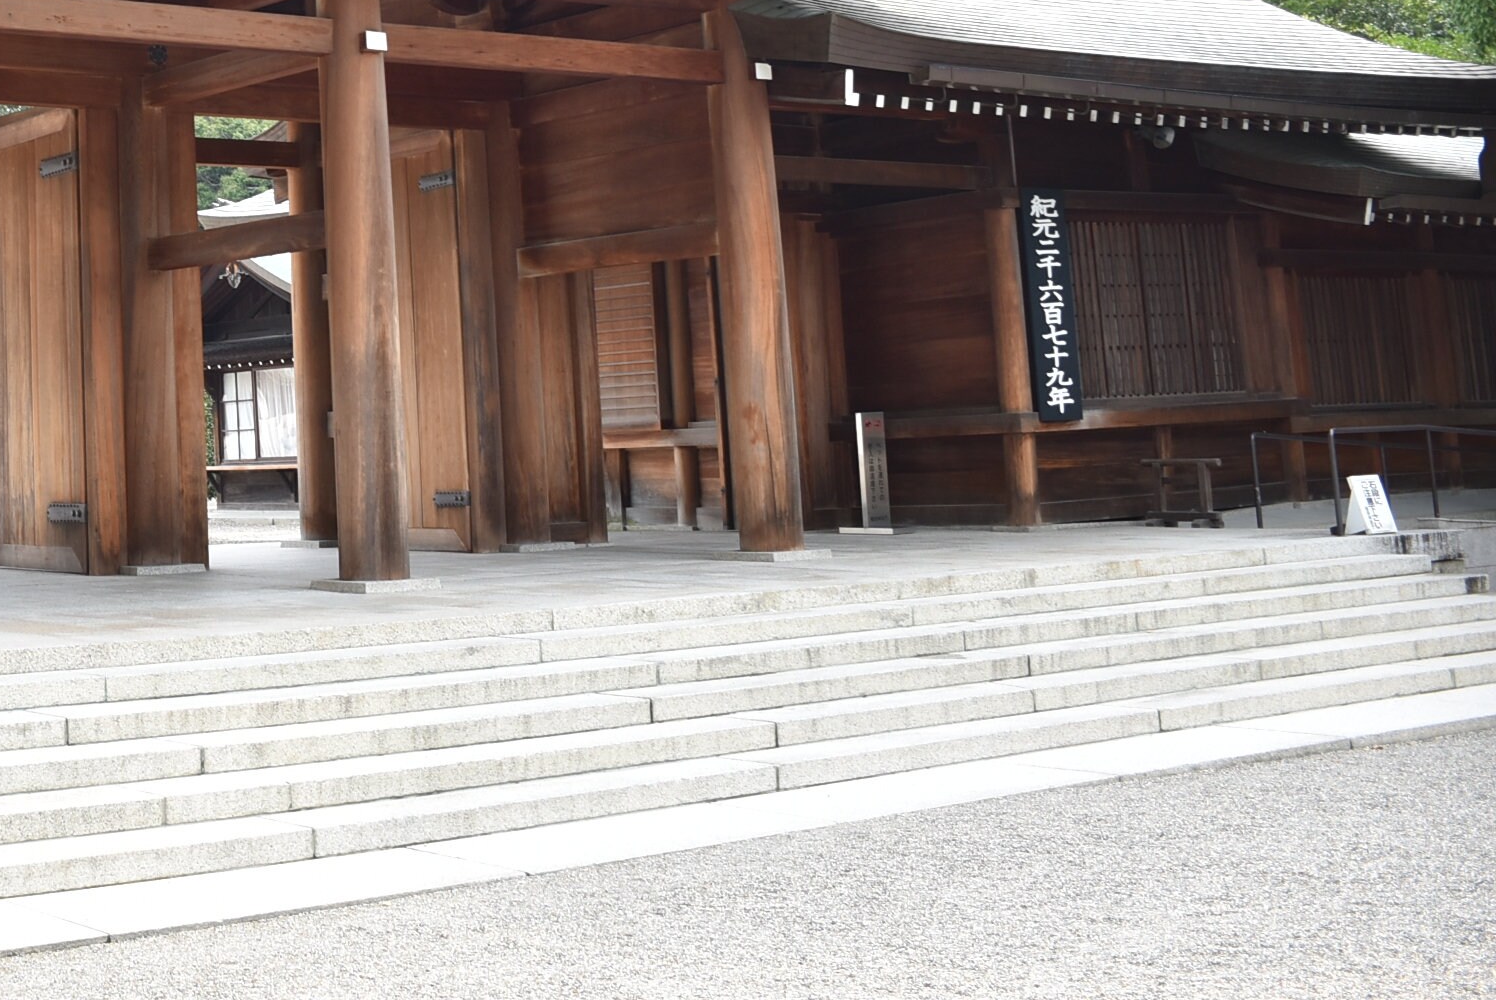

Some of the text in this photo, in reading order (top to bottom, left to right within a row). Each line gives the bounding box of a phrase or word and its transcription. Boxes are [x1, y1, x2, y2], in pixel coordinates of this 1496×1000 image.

[1029, 194, 1075, 414] 紀元二千六百七十九年
